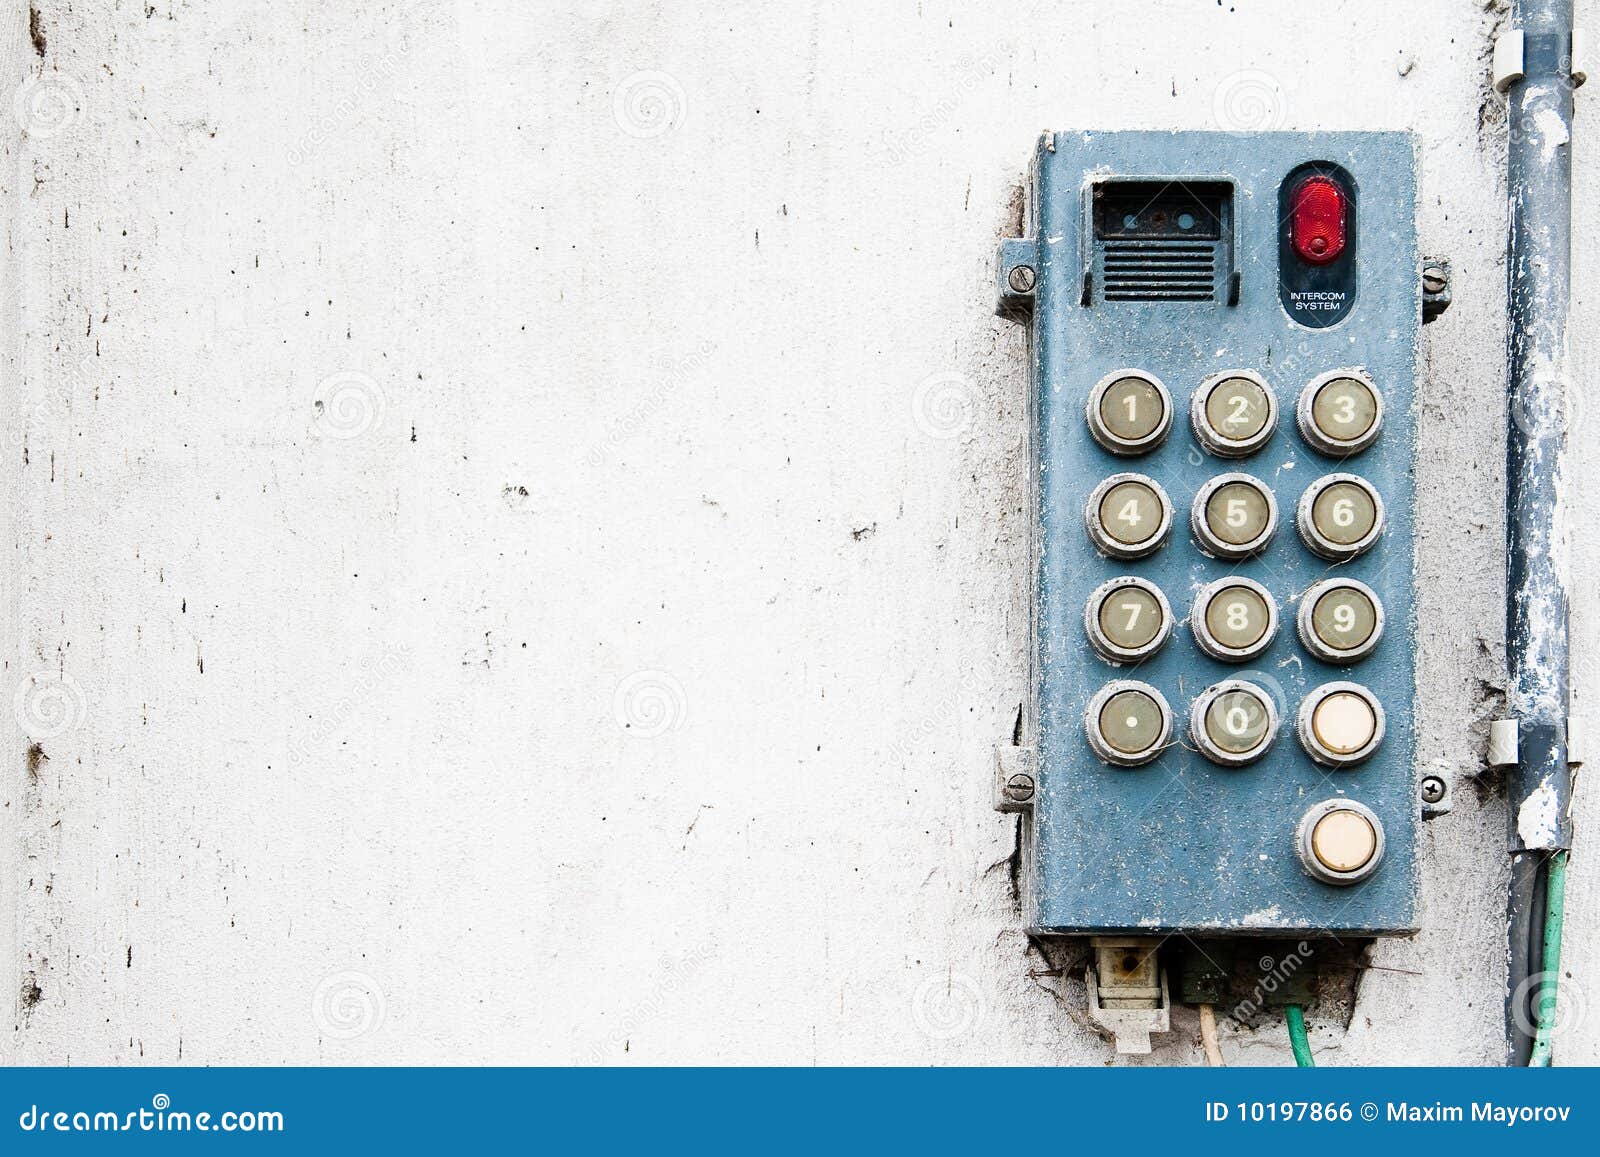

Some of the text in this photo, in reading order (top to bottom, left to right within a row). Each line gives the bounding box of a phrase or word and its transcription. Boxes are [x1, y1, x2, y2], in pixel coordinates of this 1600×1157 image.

[1290, 292, 1345, 301] INTERCOM
[1295, 302, 1340, 310] SYSTEM
[1123, 395, 1137, 422] 1
[1226, 396, 1249, 424] 2
[1333, 395, 1357, 424] 3
[1117, 499, 1142, 527] 4
[1226, 499, 1248, 528] 5
[1332, 499, 1355, 528] 6
[1121, 603, 1142, 632] 7
[1226, 603, 1249, 631] 8
[1333, 604, 1356, 633] 9
[1226, 707, 1249, 735] 0
